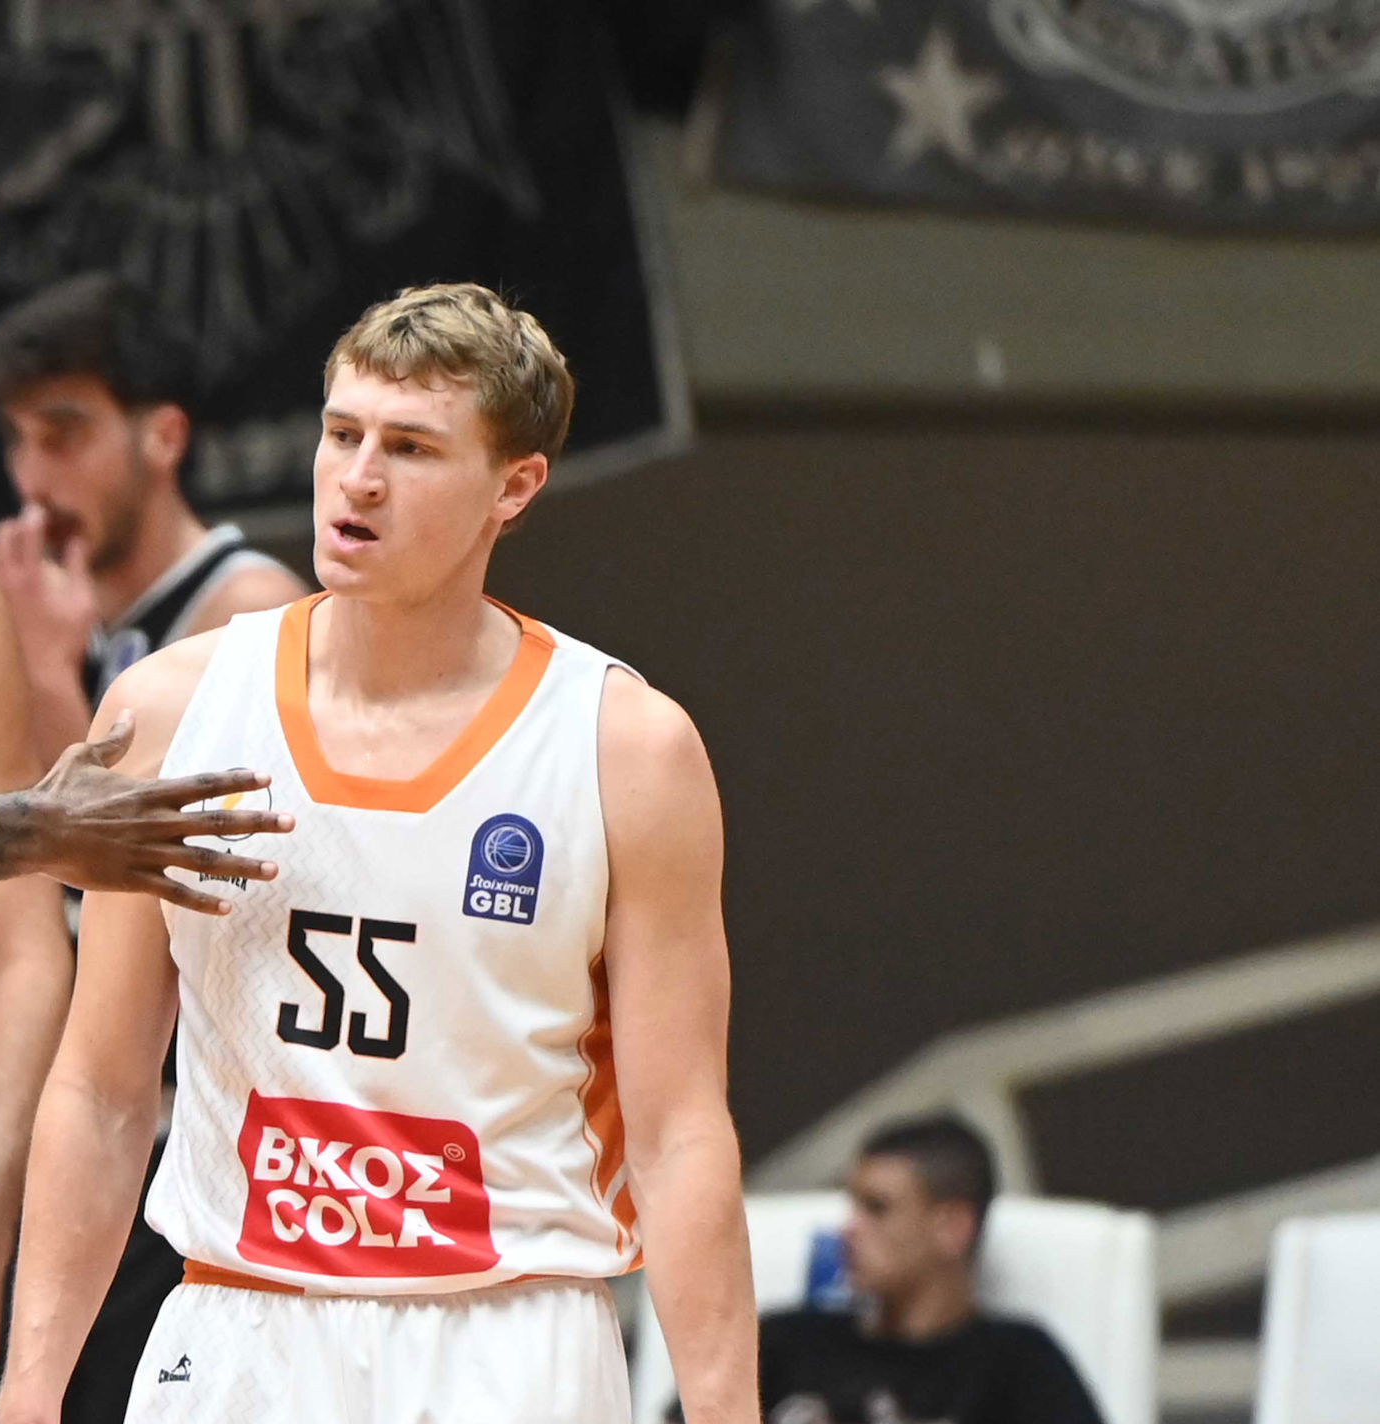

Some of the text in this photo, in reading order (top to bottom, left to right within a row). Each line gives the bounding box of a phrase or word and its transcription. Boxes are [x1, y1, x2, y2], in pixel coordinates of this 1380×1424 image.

[469, 874, 535, 896] Stoiximan
[470, 890, 528, 919] GBL
[275, 908, 417, 1061] 55
[266, 1190, 455, 1247] COLA
